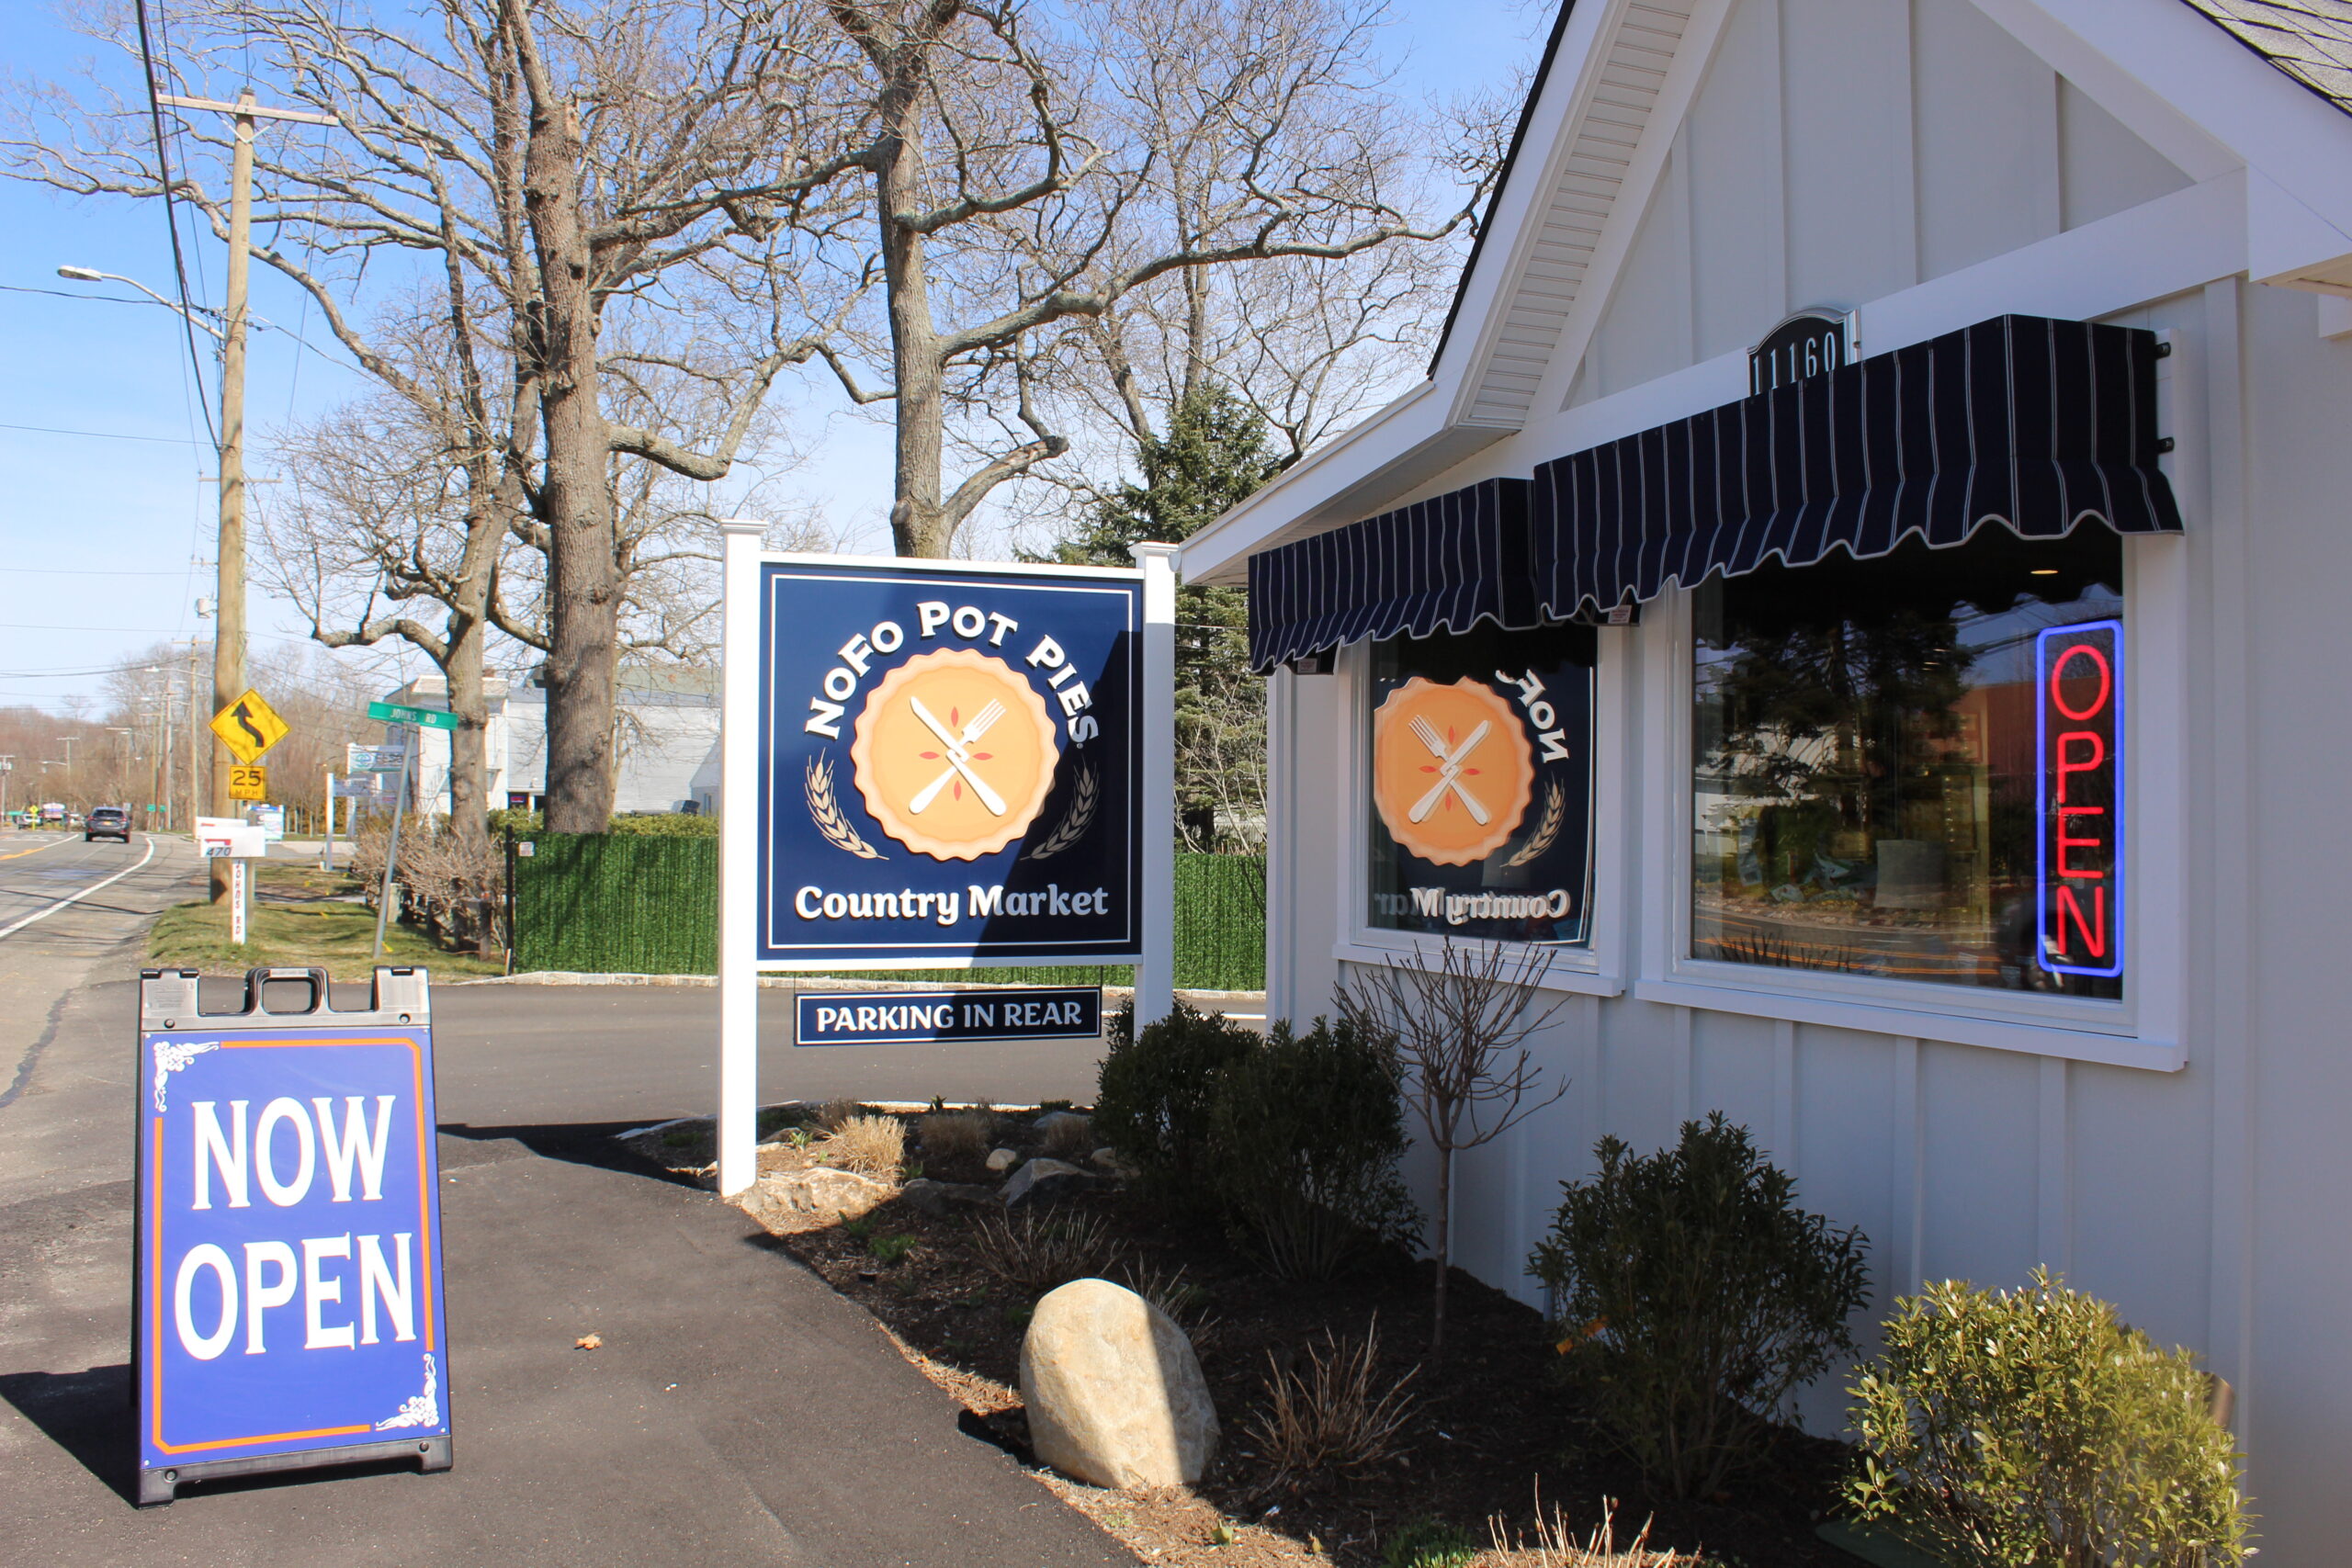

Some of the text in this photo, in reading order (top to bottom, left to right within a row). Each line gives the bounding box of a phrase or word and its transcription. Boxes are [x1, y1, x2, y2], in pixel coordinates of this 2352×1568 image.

[1753, 331, 1837, 396] 11160
[804, 600, 1100, 745] NOFO POT PIES
[390, 708, 437, 724] JOHNS RD
[232, 769, 262, 787] 25
[2052, 644, 2110, 958] OPEN
[206, 847, 232, 857] 470
[795, 883, 1109, 926] Country Market
[816, 1000, 1083, 1032] PARKING IN REAR
[191, 1094, 397, 1211] NOW
[175, 1231, 417, 1361] OPEN
